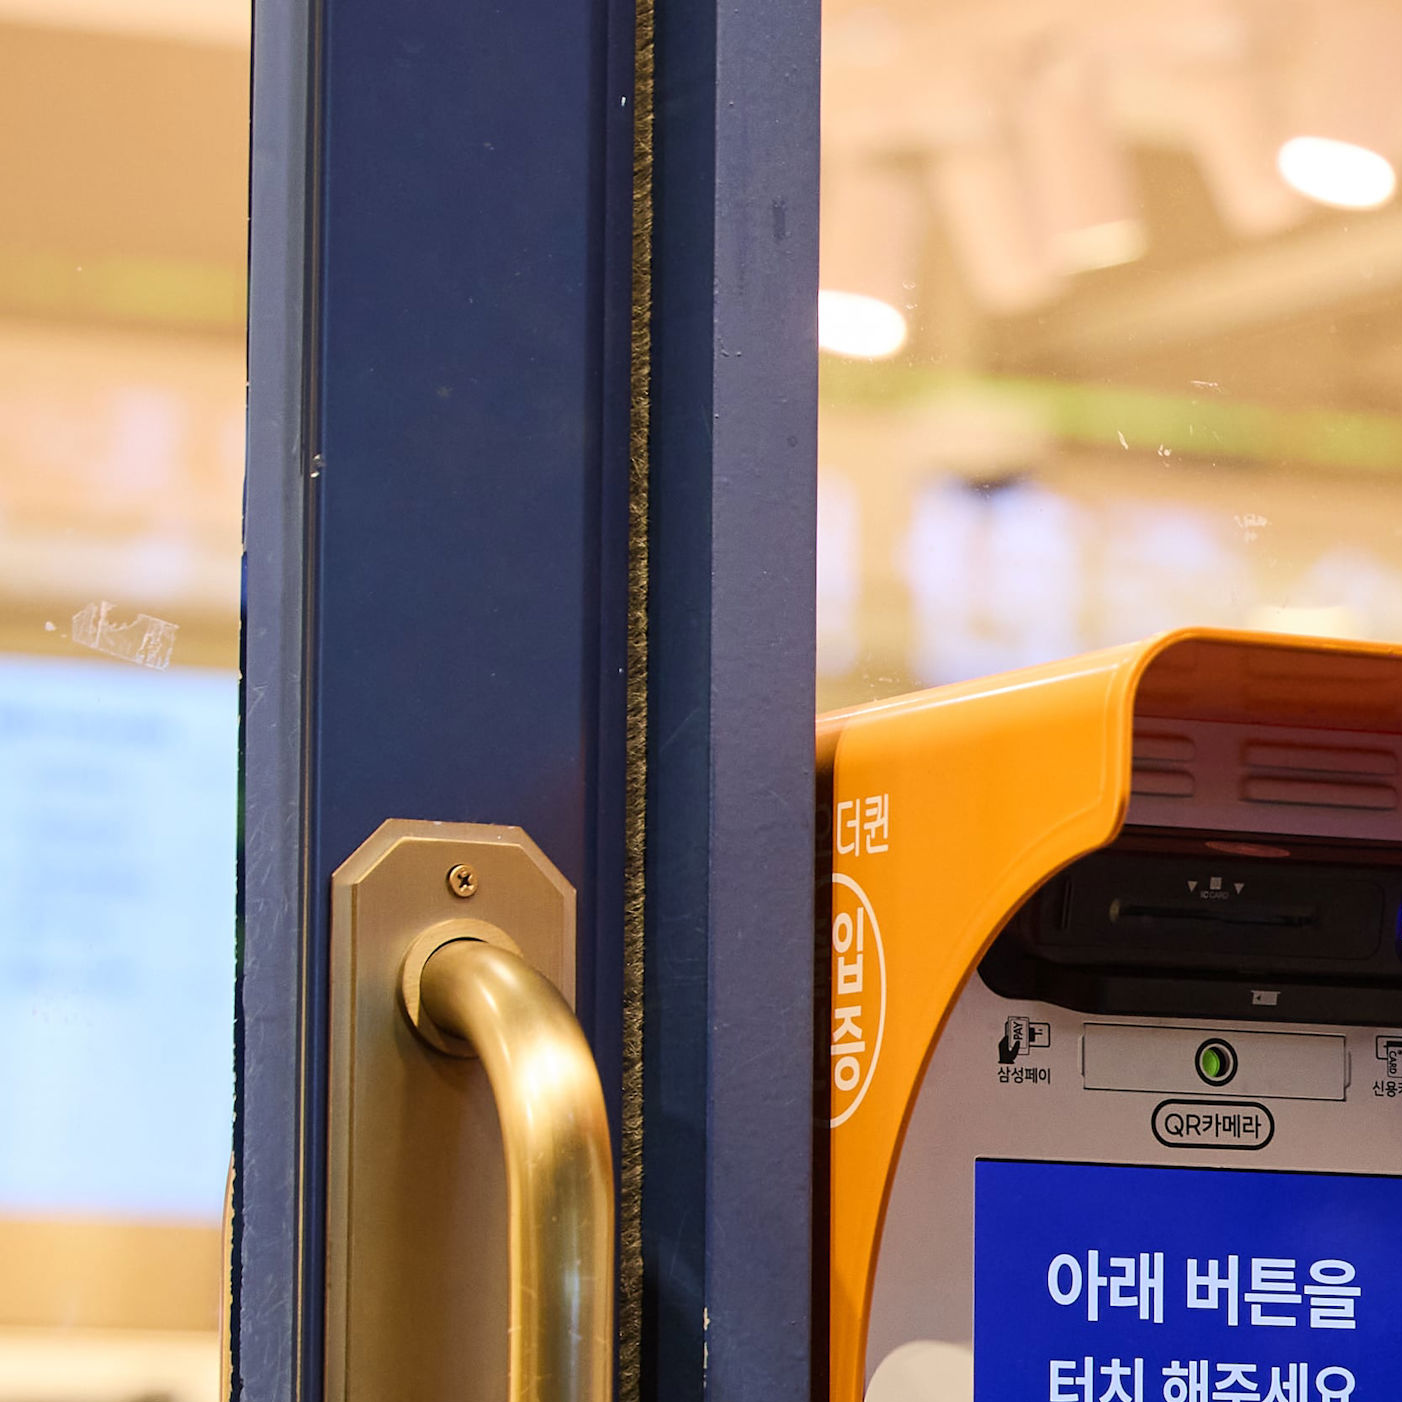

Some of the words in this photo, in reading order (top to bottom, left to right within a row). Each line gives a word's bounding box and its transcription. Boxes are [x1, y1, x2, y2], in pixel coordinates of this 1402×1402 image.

[836, 793, 889, 857] 더퀸
[1012, 1021, 1024, 1040] PAY
[997, 1066, 1051, 1085] 삼성페이
[1163, 1111, 1262, 1139] QR카메라
[1047, 1249, 1164, 1324] 아래
[1186, 1254, 1362, 1330] 버튼을
